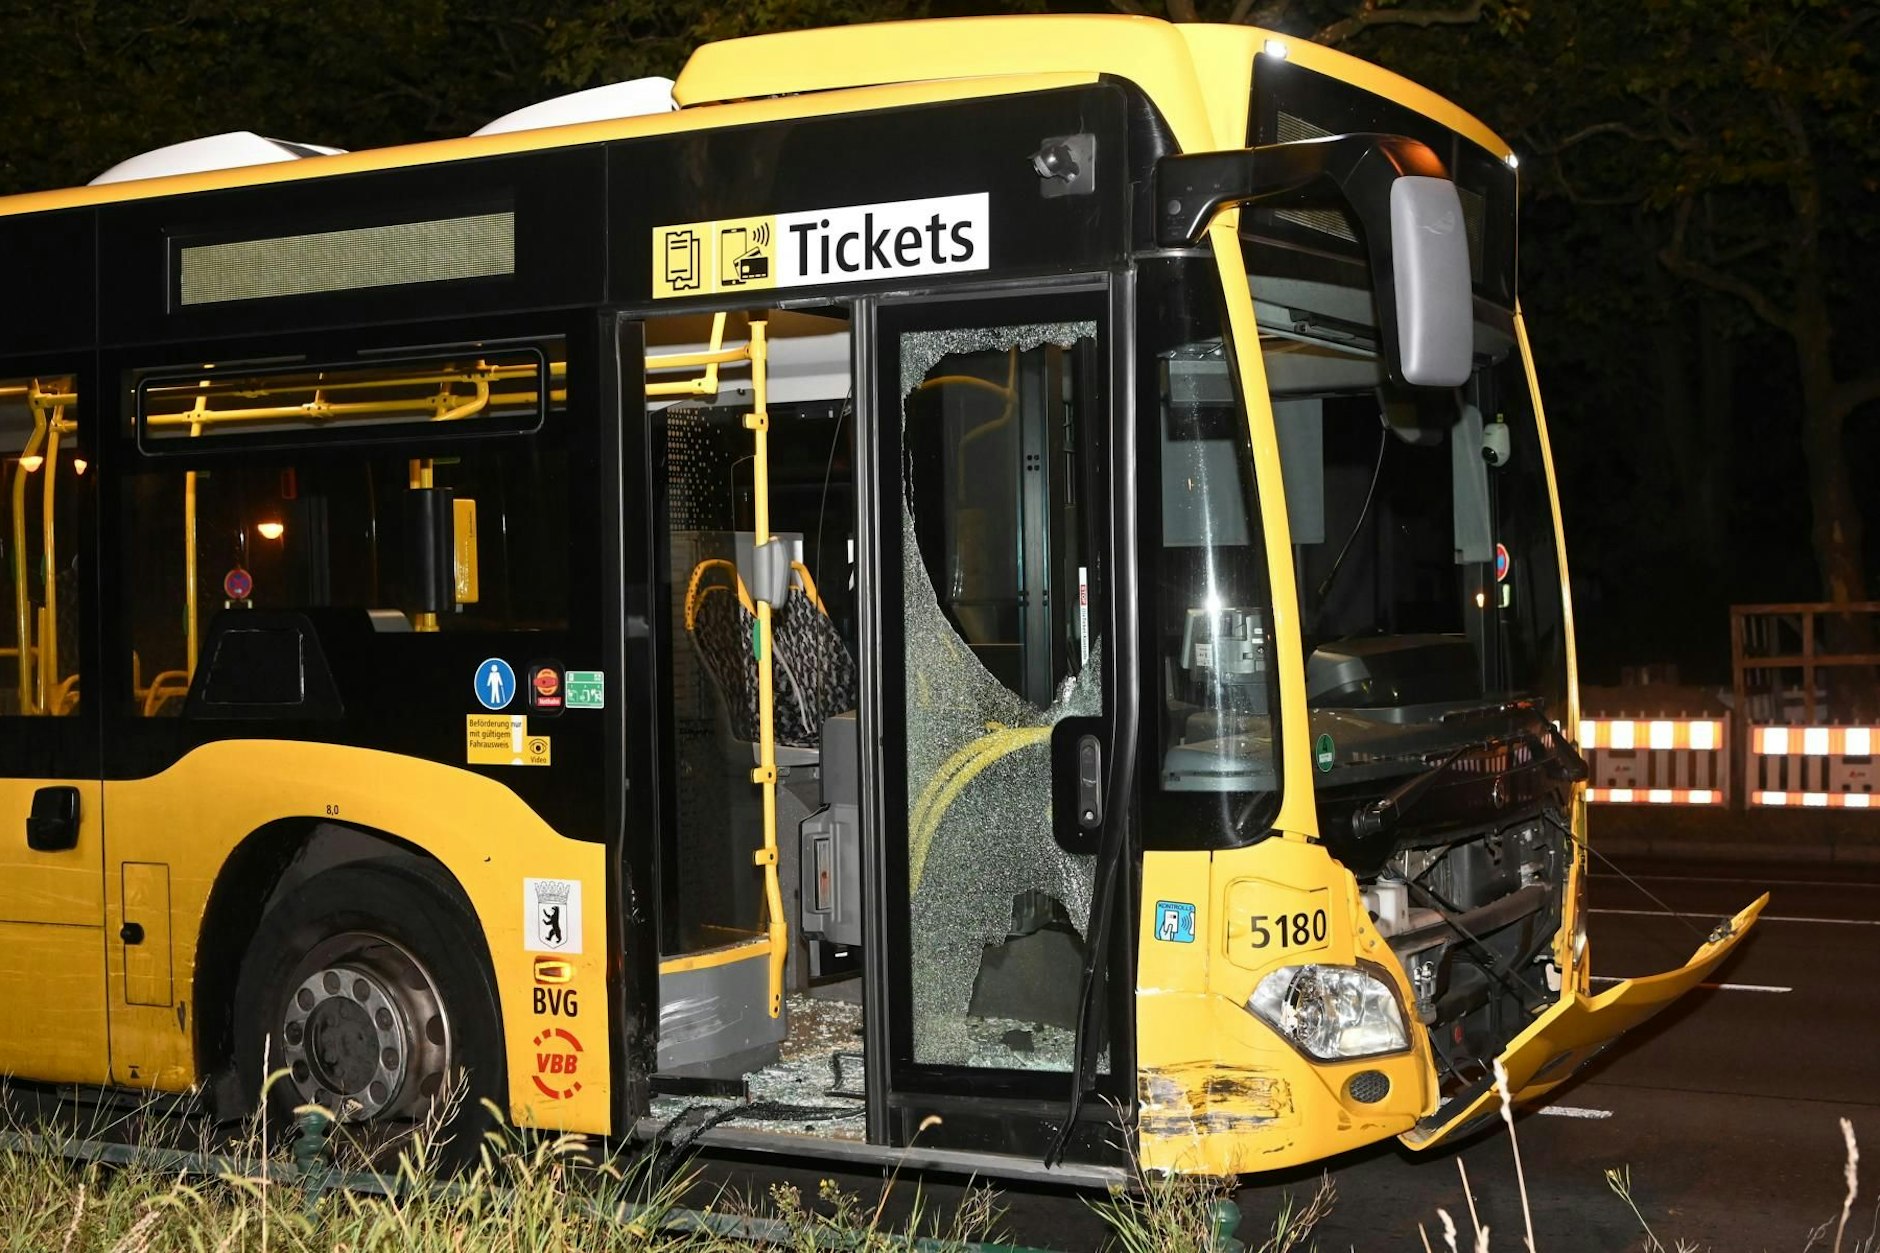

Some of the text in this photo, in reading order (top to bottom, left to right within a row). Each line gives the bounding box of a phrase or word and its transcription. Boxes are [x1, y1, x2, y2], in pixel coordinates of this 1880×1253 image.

[789, 212, 974, 276] Tickets
[469, 719, 509, 729] Beförderung
[481, 730, 511, 739] gültigem
[469, 740, 509, 748] Fahrausweis
[530, 756, 547, 764] Video
[326, 804, 339, 816] 8,0
[1158, 903, 1193, 911] KONTROLLE
[1251, 909, 1327, 949] 5180
[533, 987, 578, 1017] BVG
[536, 1053, 578, 1074] VBB
